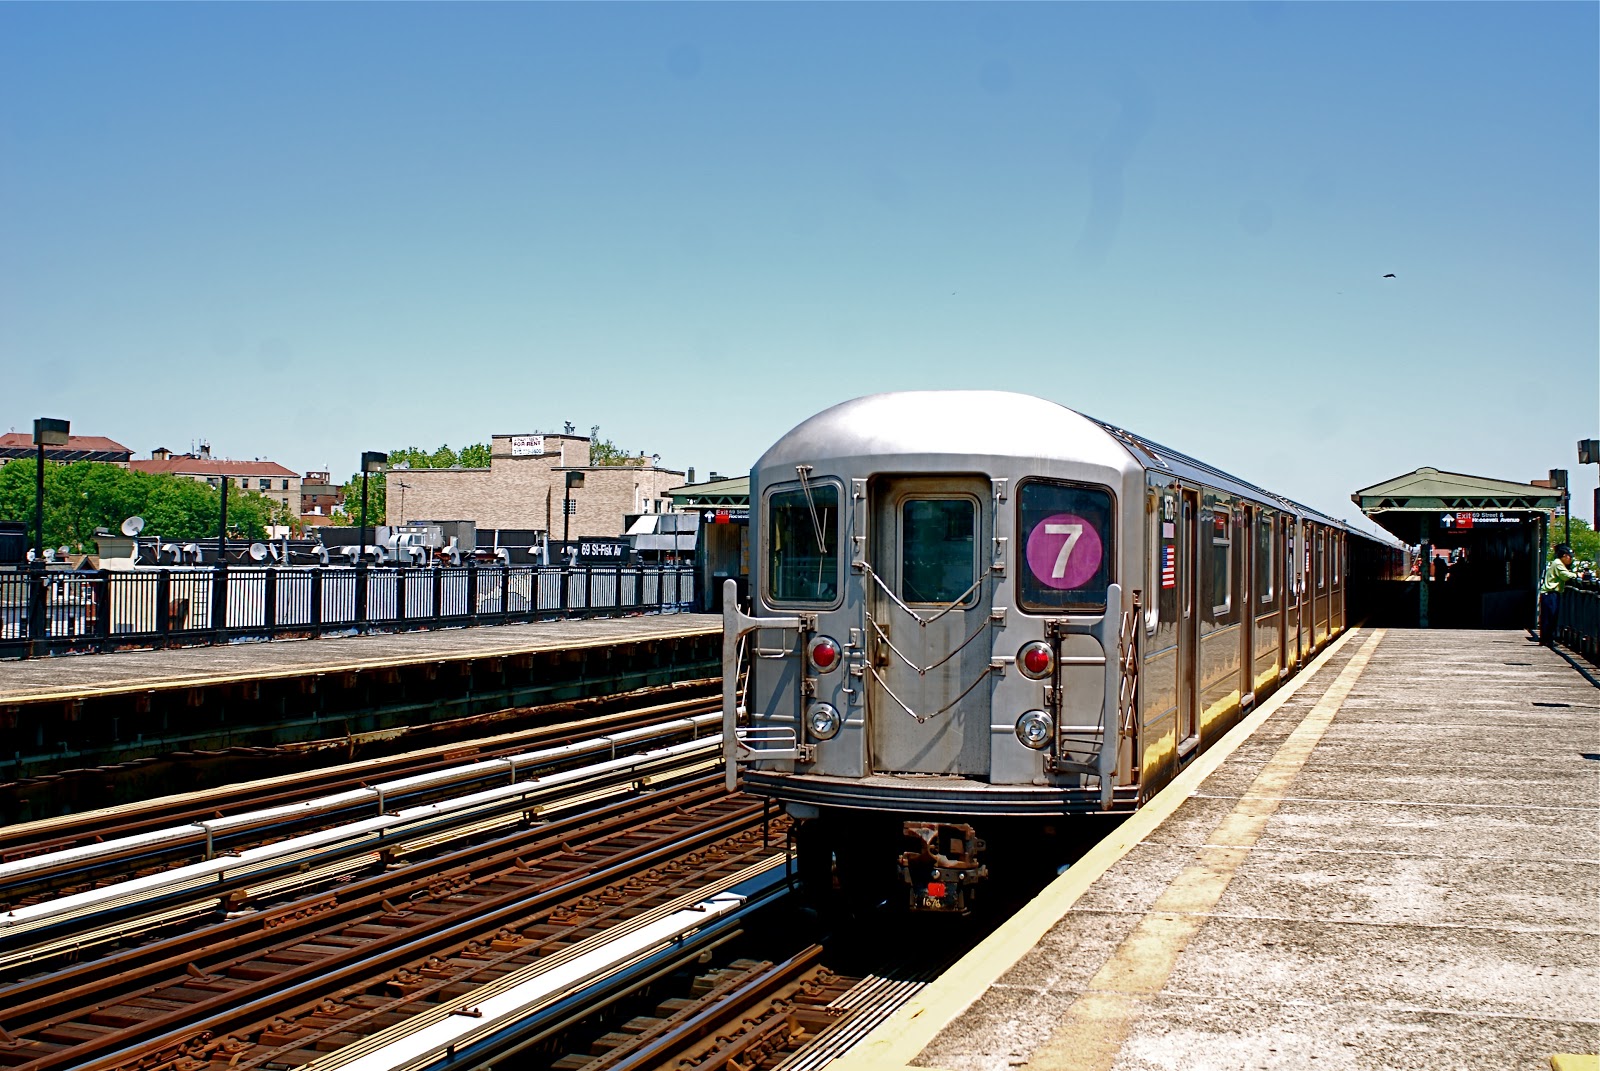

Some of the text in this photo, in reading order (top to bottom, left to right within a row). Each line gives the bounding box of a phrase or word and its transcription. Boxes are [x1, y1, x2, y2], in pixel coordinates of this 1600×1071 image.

[581, 543, 591, 556] 69
[613, 544, 622, 556] Av
[1044, 524, 1083, 579] 7
